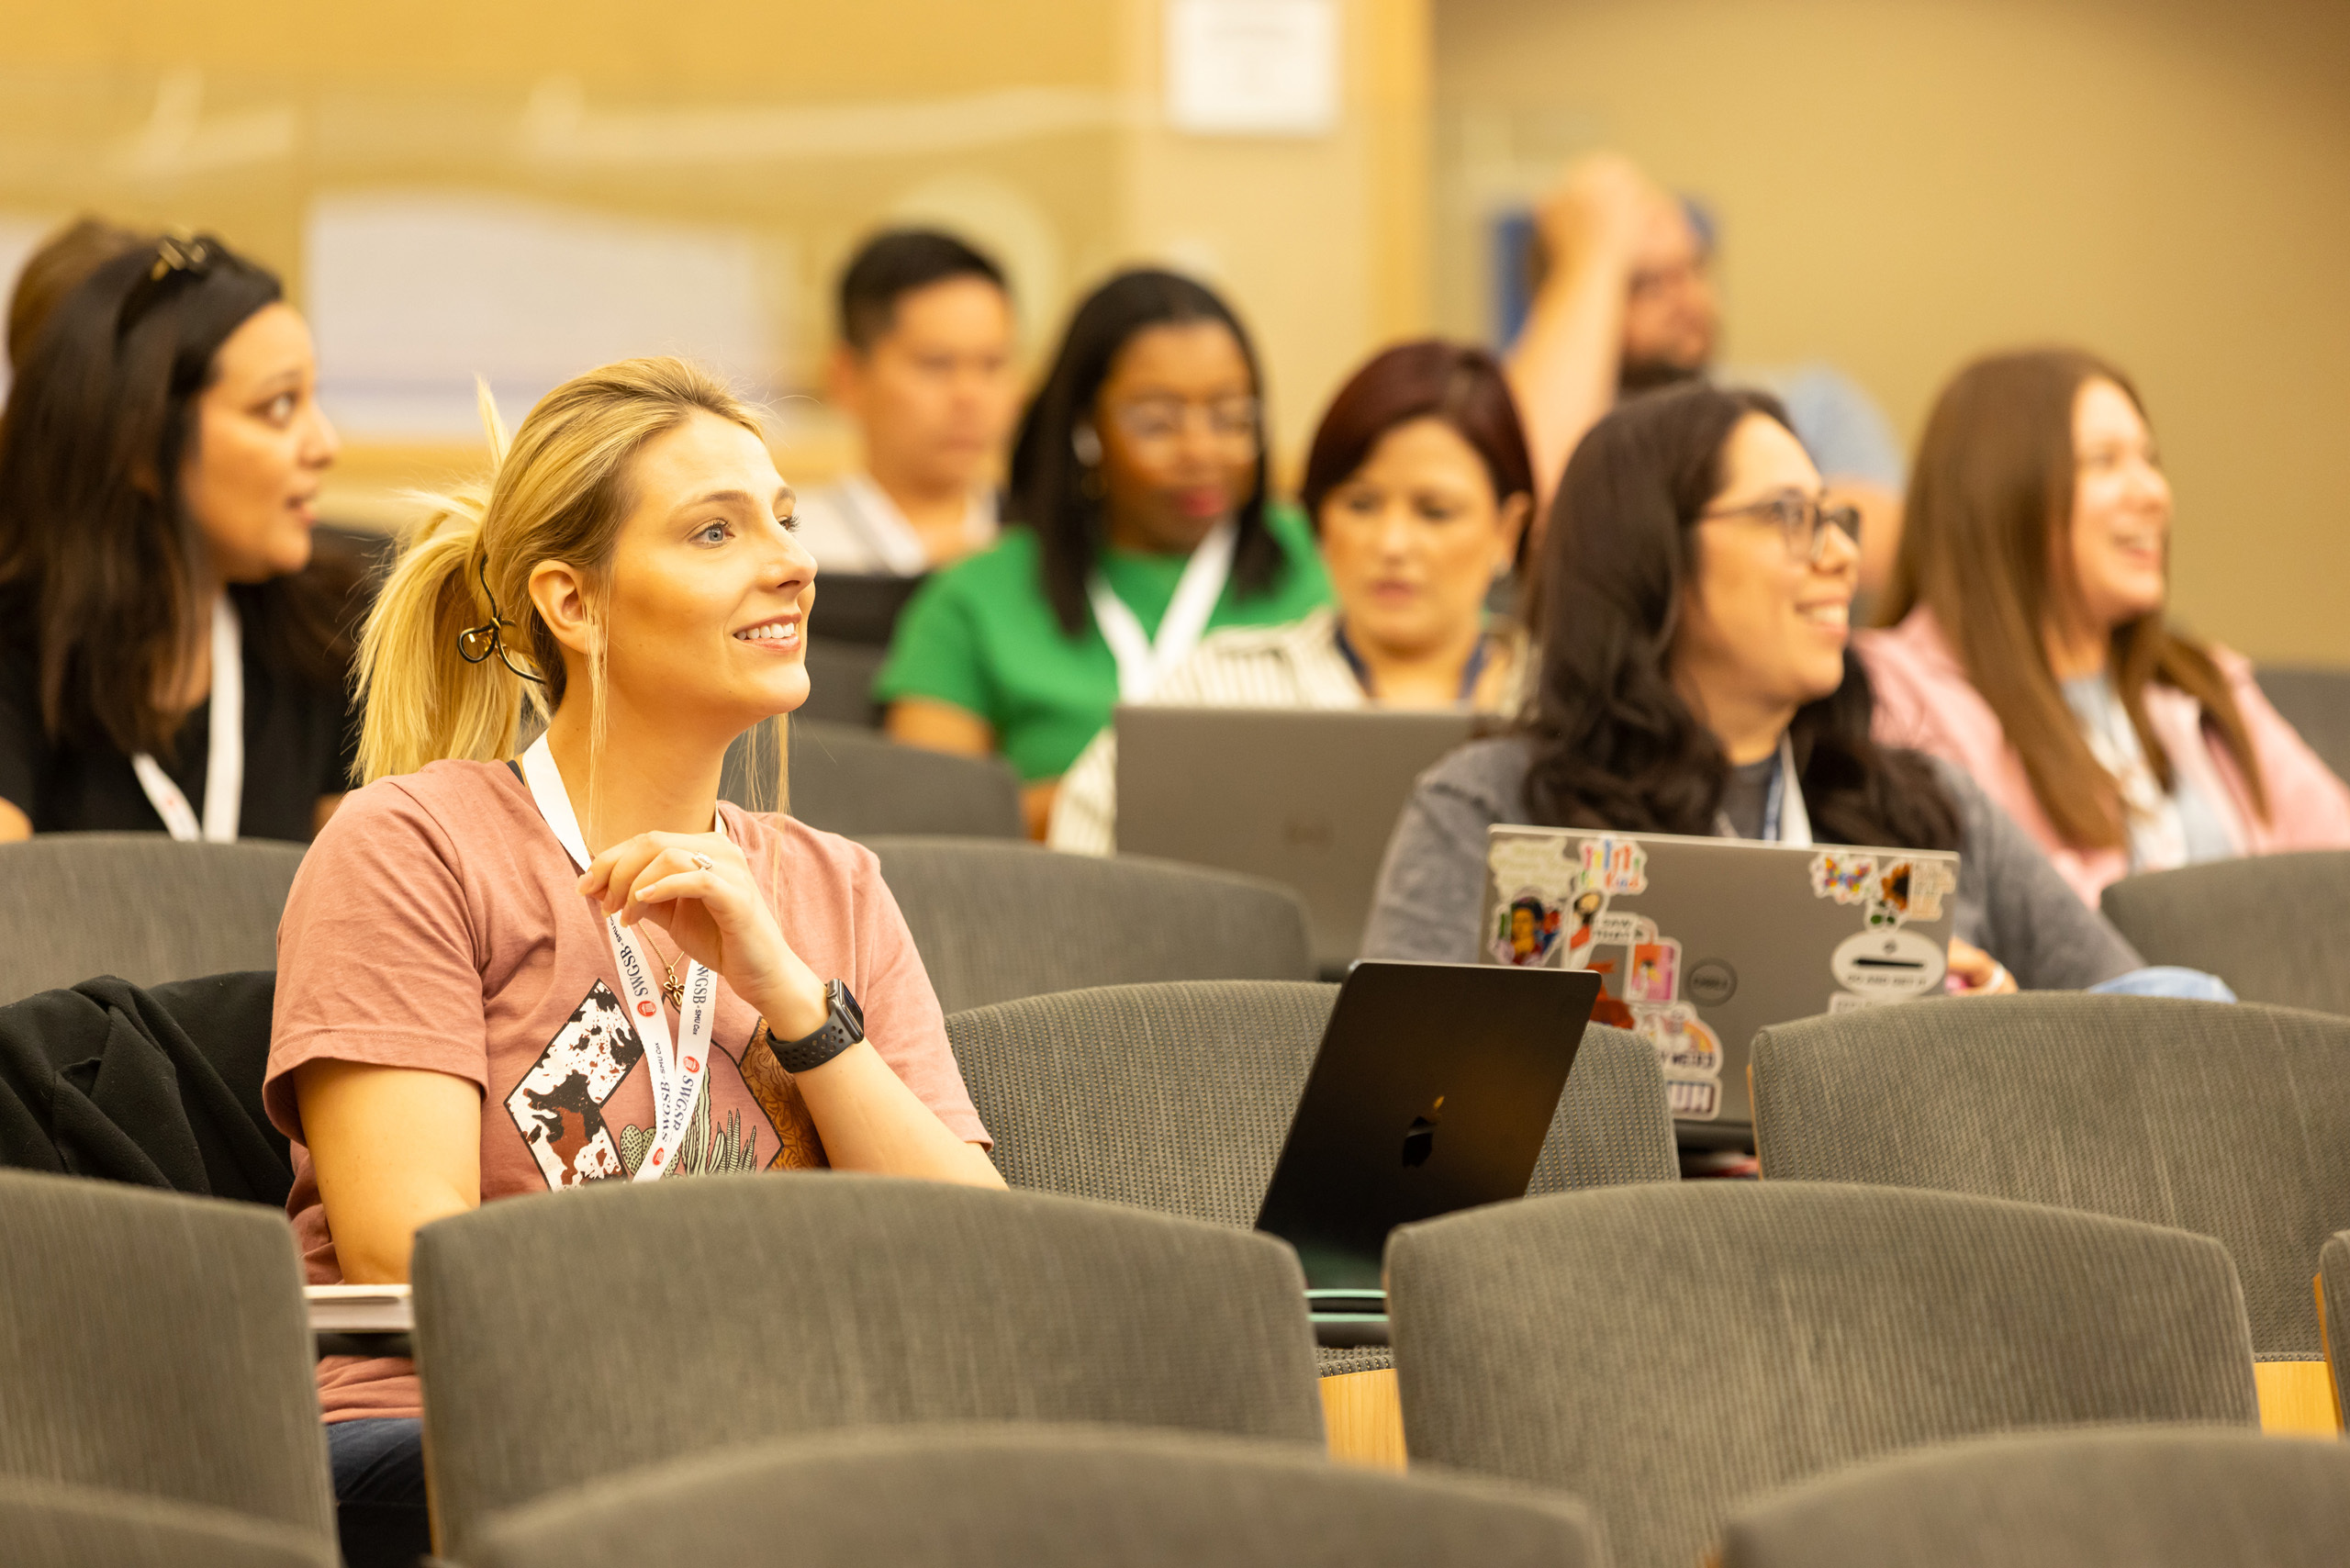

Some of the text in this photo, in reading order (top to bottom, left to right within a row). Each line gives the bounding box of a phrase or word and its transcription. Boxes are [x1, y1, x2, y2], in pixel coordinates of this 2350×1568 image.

[621, 946, 648, 997] SWGSB
[692, 963, 710, 1036] WGSB SMU Cox
[657, 1056, 666, 1074] SMU
[660, 1081, 671, 1142] SWGSB
